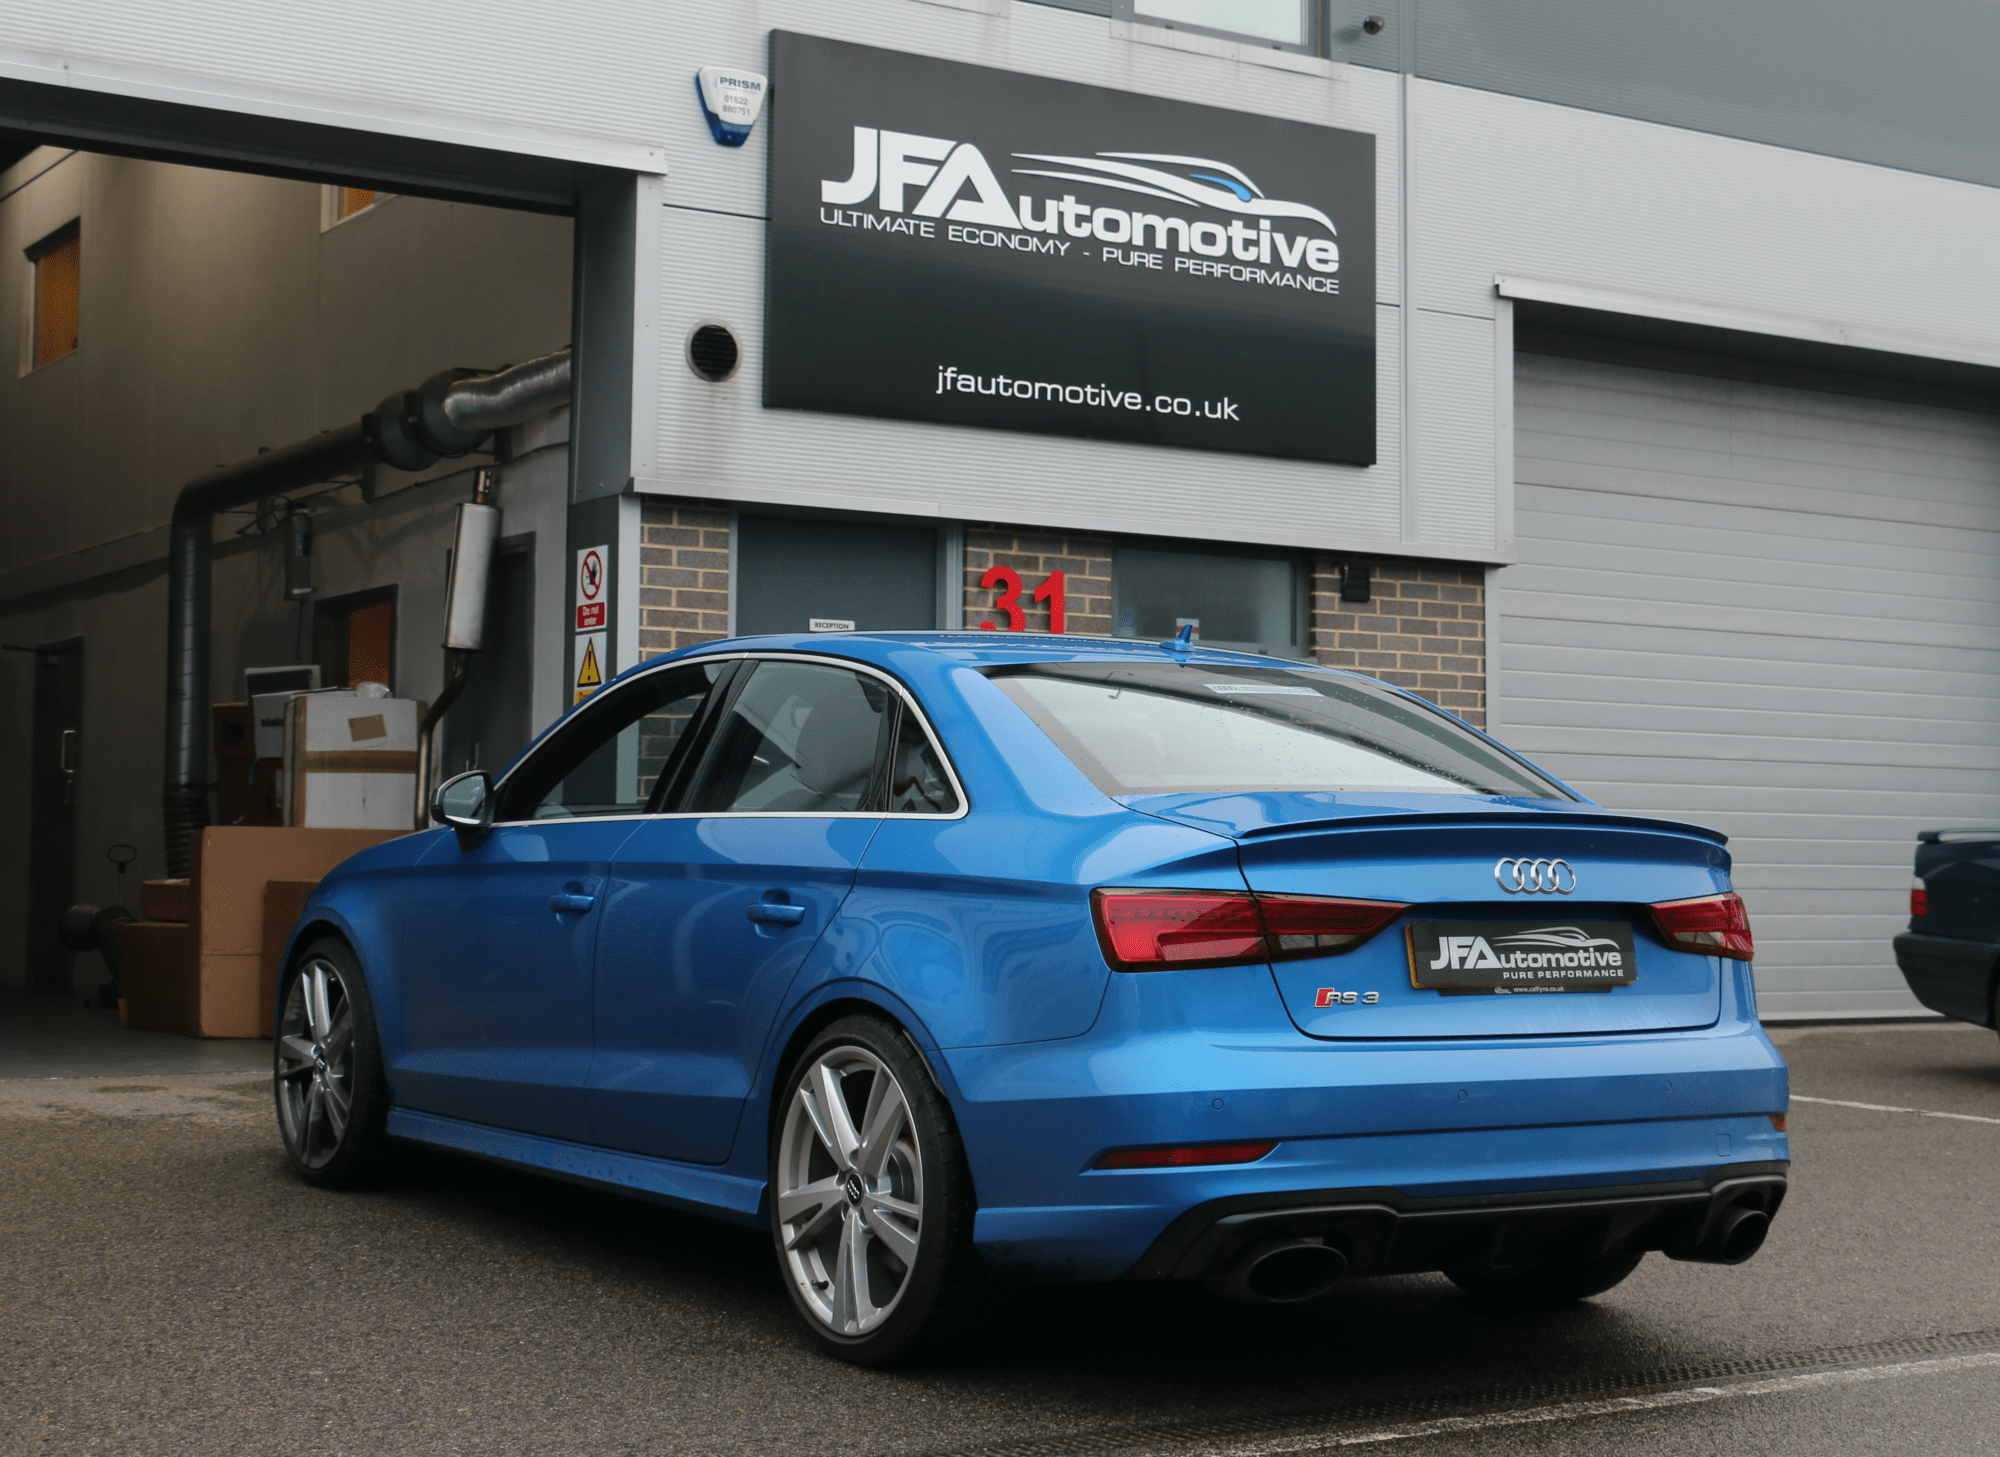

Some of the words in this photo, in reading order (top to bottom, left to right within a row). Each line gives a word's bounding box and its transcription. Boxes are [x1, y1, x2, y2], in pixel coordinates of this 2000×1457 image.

[719, 76, 761, 91] PRISM
[724, 94, 748, 105] 01622
[820, 207, 935, 239] ULTIMATE
[948, 224, 1071, 257] ECONOMY
[1102, 246, 1163, 270] PURE
[1174, 256, 1340, 295] PERFORMANCE
[935, 365, 1240, 421] jfautomotive.co.uk
[980, 565, 1065, 634] 31
[814, 621, 849, 630] RECEPTION
[1502, 971, 1534, 980] PURE
[1537, 969, 1624, 979] PERFORMANCE
[1325, 991, 1359, 1005] RS
[1362, 991, 1380, 1004] 3
